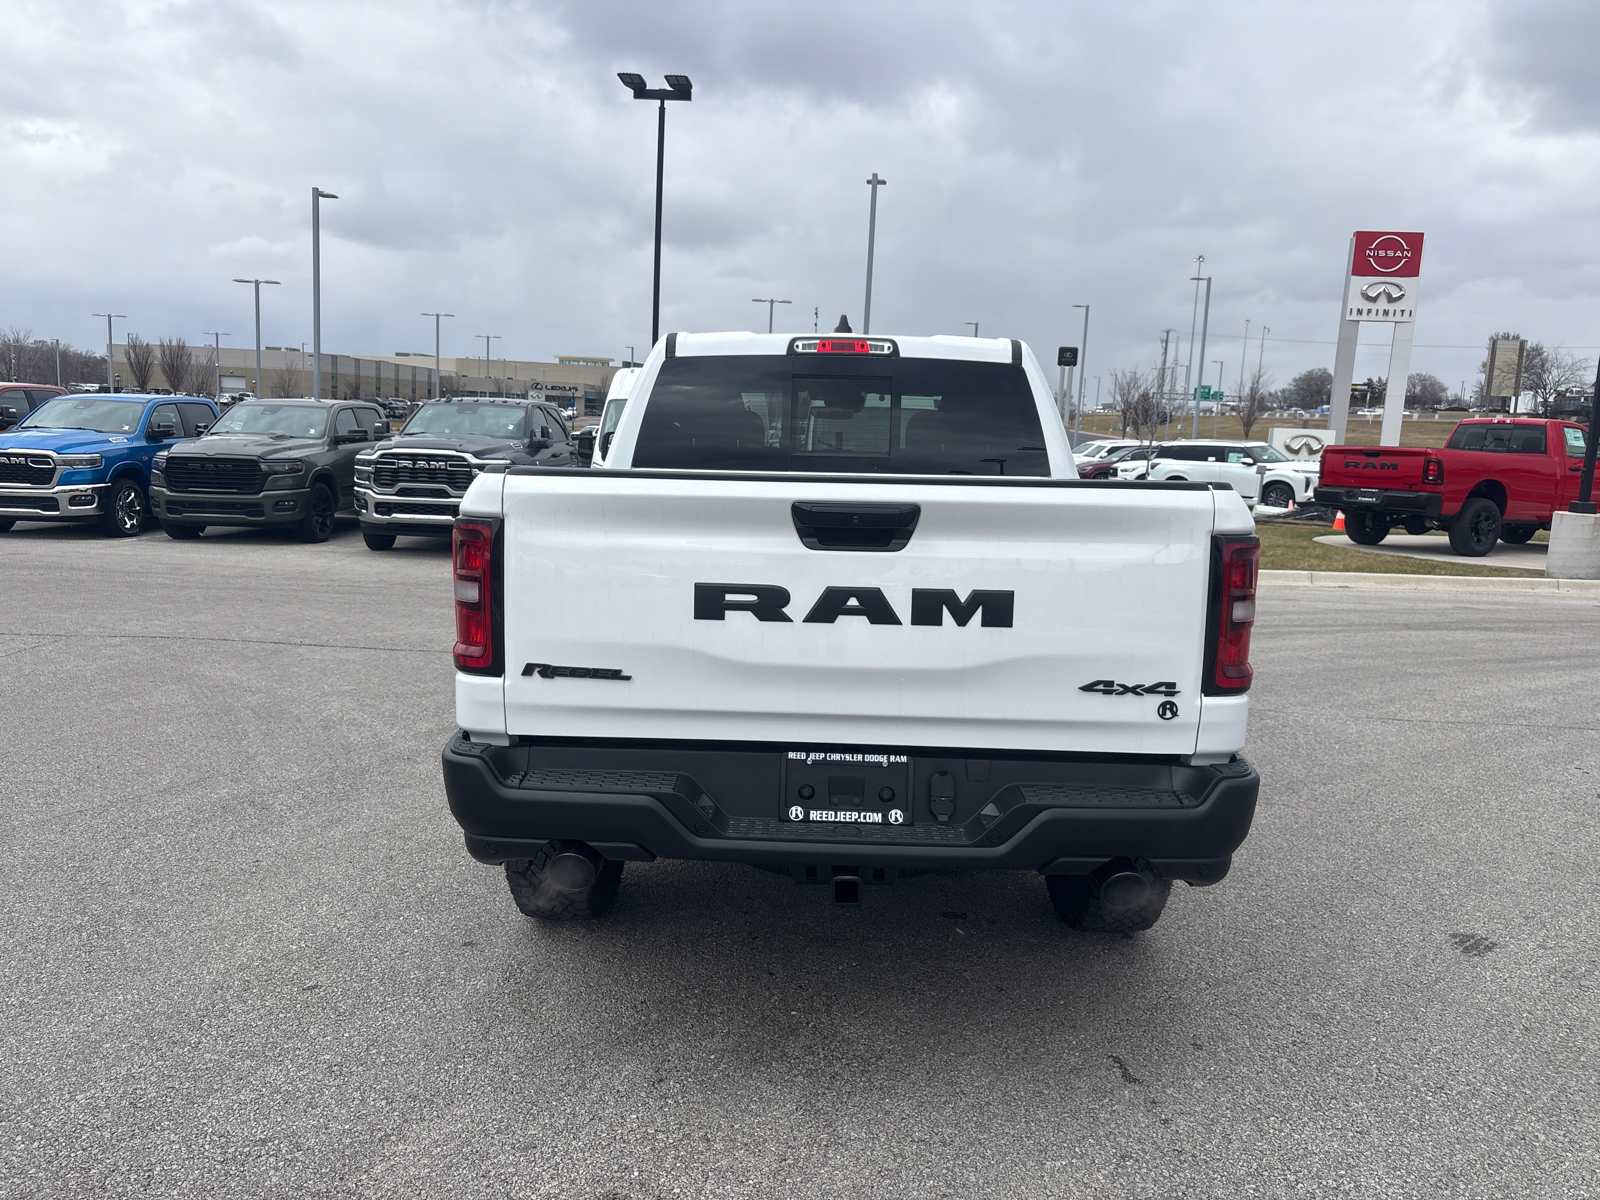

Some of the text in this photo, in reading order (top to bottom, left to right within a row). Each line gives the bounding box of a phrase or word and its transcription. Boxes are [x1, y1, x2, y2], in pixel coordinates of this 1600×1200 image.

[1366, 249, 1411, 257] NISSAN
[1349, 308, 1412, 317] INFINITI
[0, 457, 26, 465] AM
[398, 460, 446, 470] RAM
[1344, 461, 1399, 471] RAM
[188, 463, 233, 472] RAM
[694, 582, 1015, 628] RAM
[1078, 679, 1181, 697] 4x4
[788, 751, 908, 763] REED JEEP CHRYSLER DODGE RAM
[809, 810, 882, 823] REEDJEEP.COM
